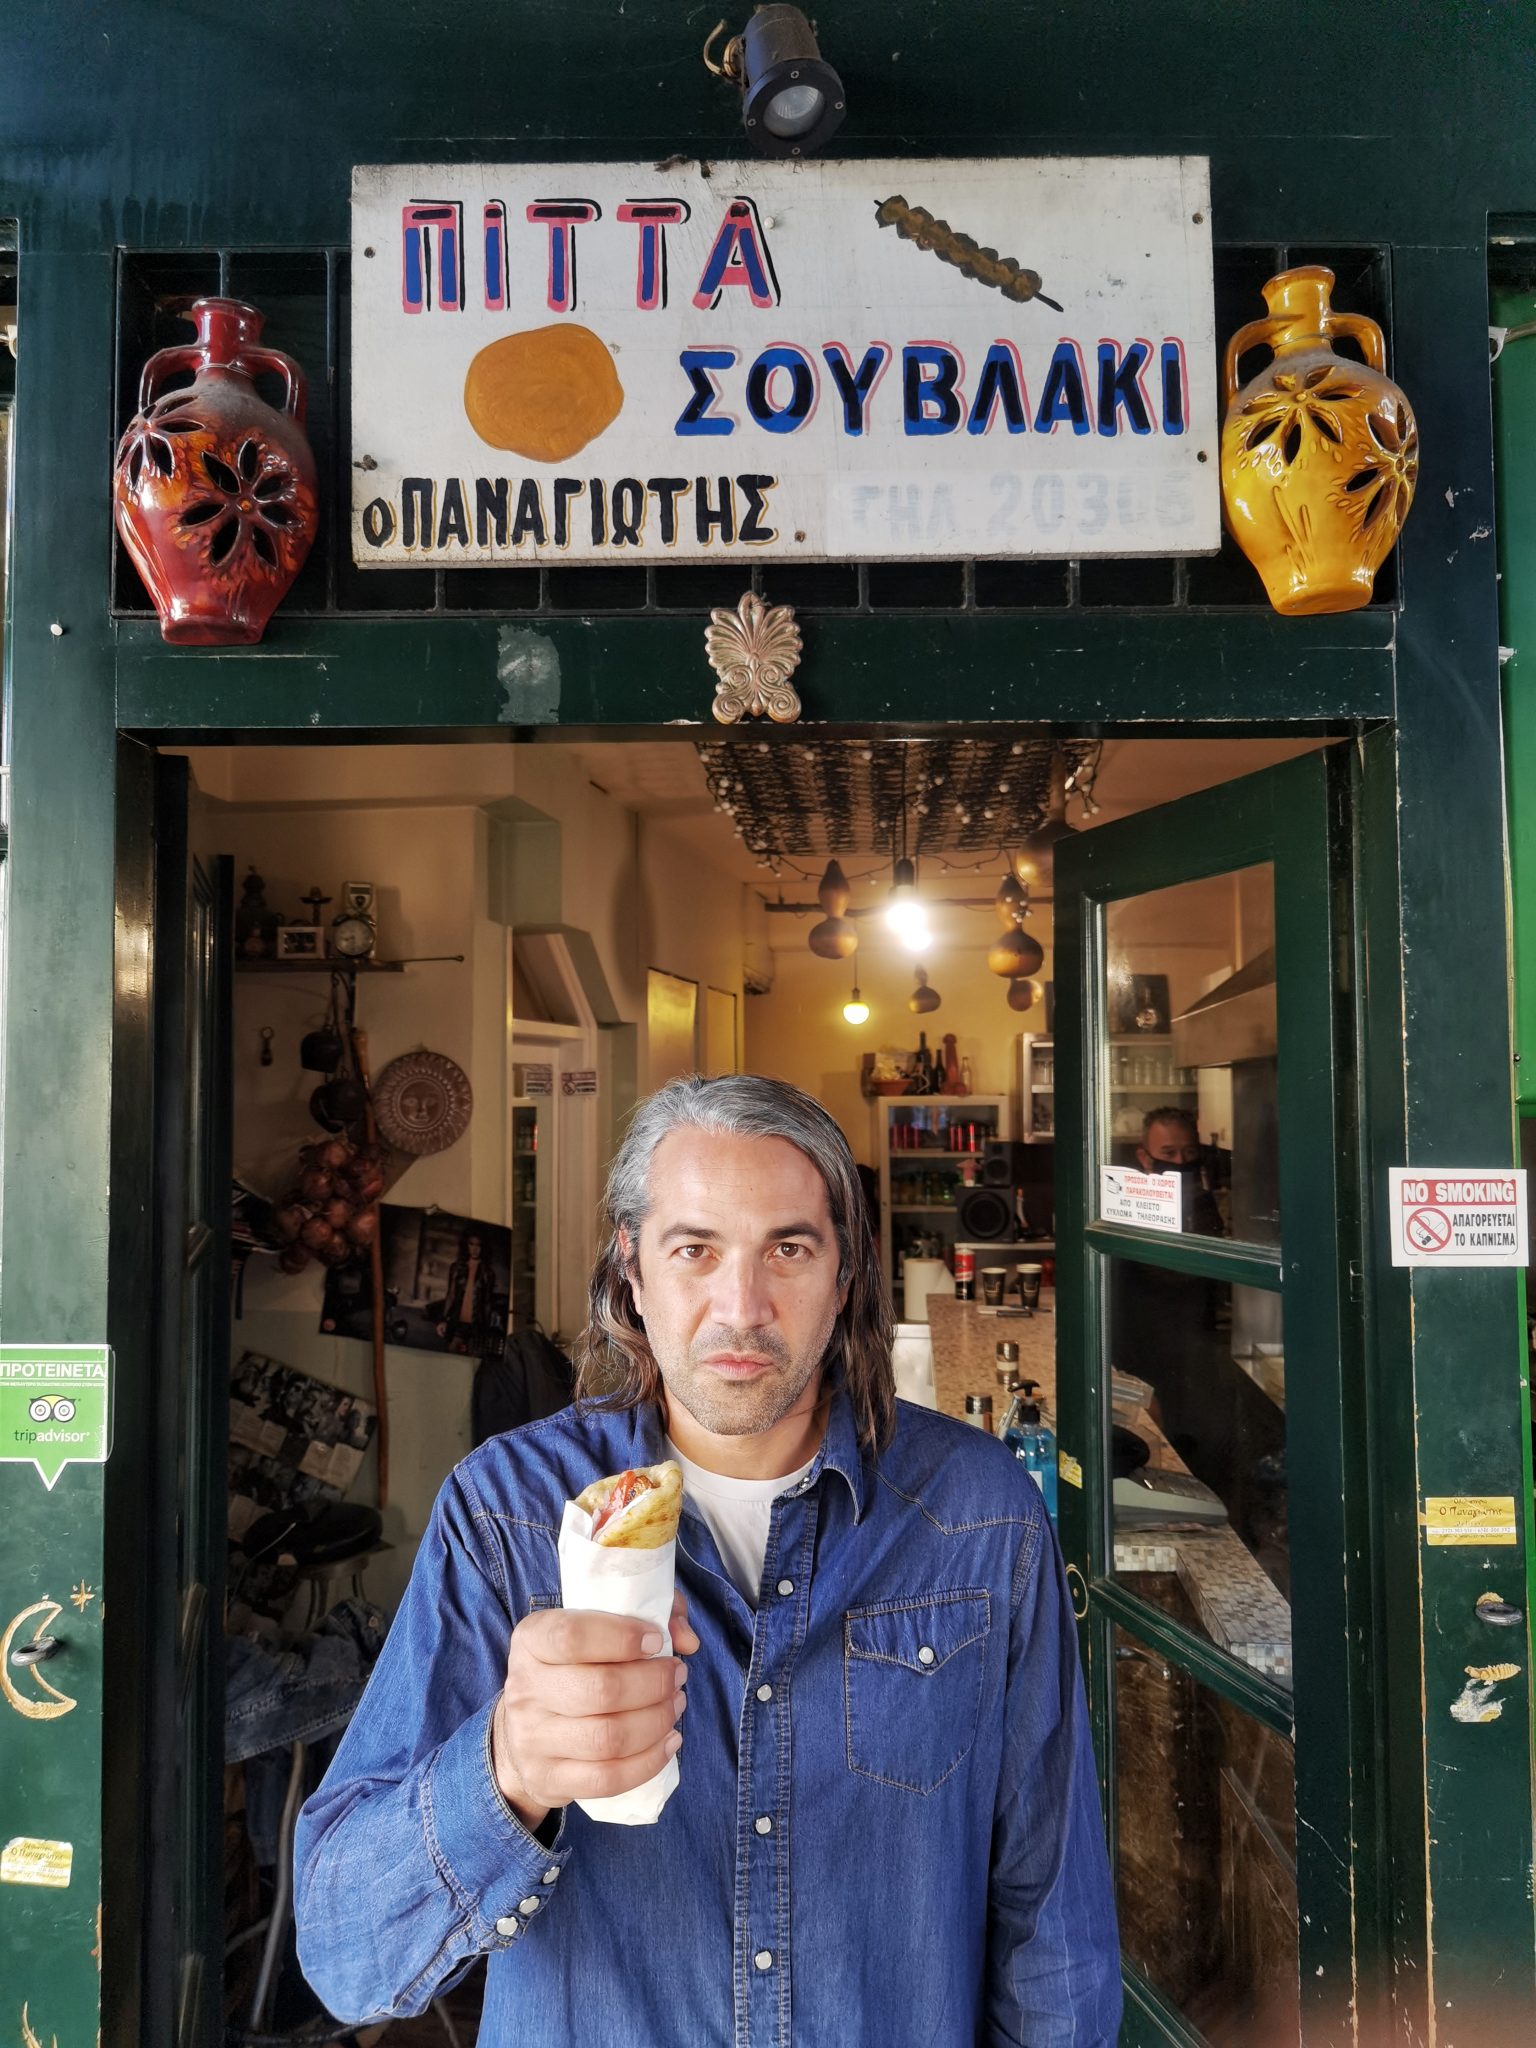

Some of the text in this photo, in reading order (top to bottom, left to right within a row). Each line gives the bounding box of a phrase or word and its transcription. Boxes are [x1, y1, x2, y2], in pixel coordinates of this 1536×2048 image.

[402, 196, 782, 314] ΠΙΤΤΑ
[674, 338, 1190, 437] ΣΟΥΒΛΑΚΙ
[401, 474, 778, 553] ΠΑΝΑΓΙΩΤΗΣ
[1403, 1182, 1515, 1203] NO SMOKING
[1452, 1213, 1515, 1227] ΑΠΑΓΟΡΕΥΕΤΑΙ
[1455, 1232, 1516, 1246] ΤΟ ΚΑΠΝΙΣΜΑ
[14, 1429, 86, 1444] tripadvisor
